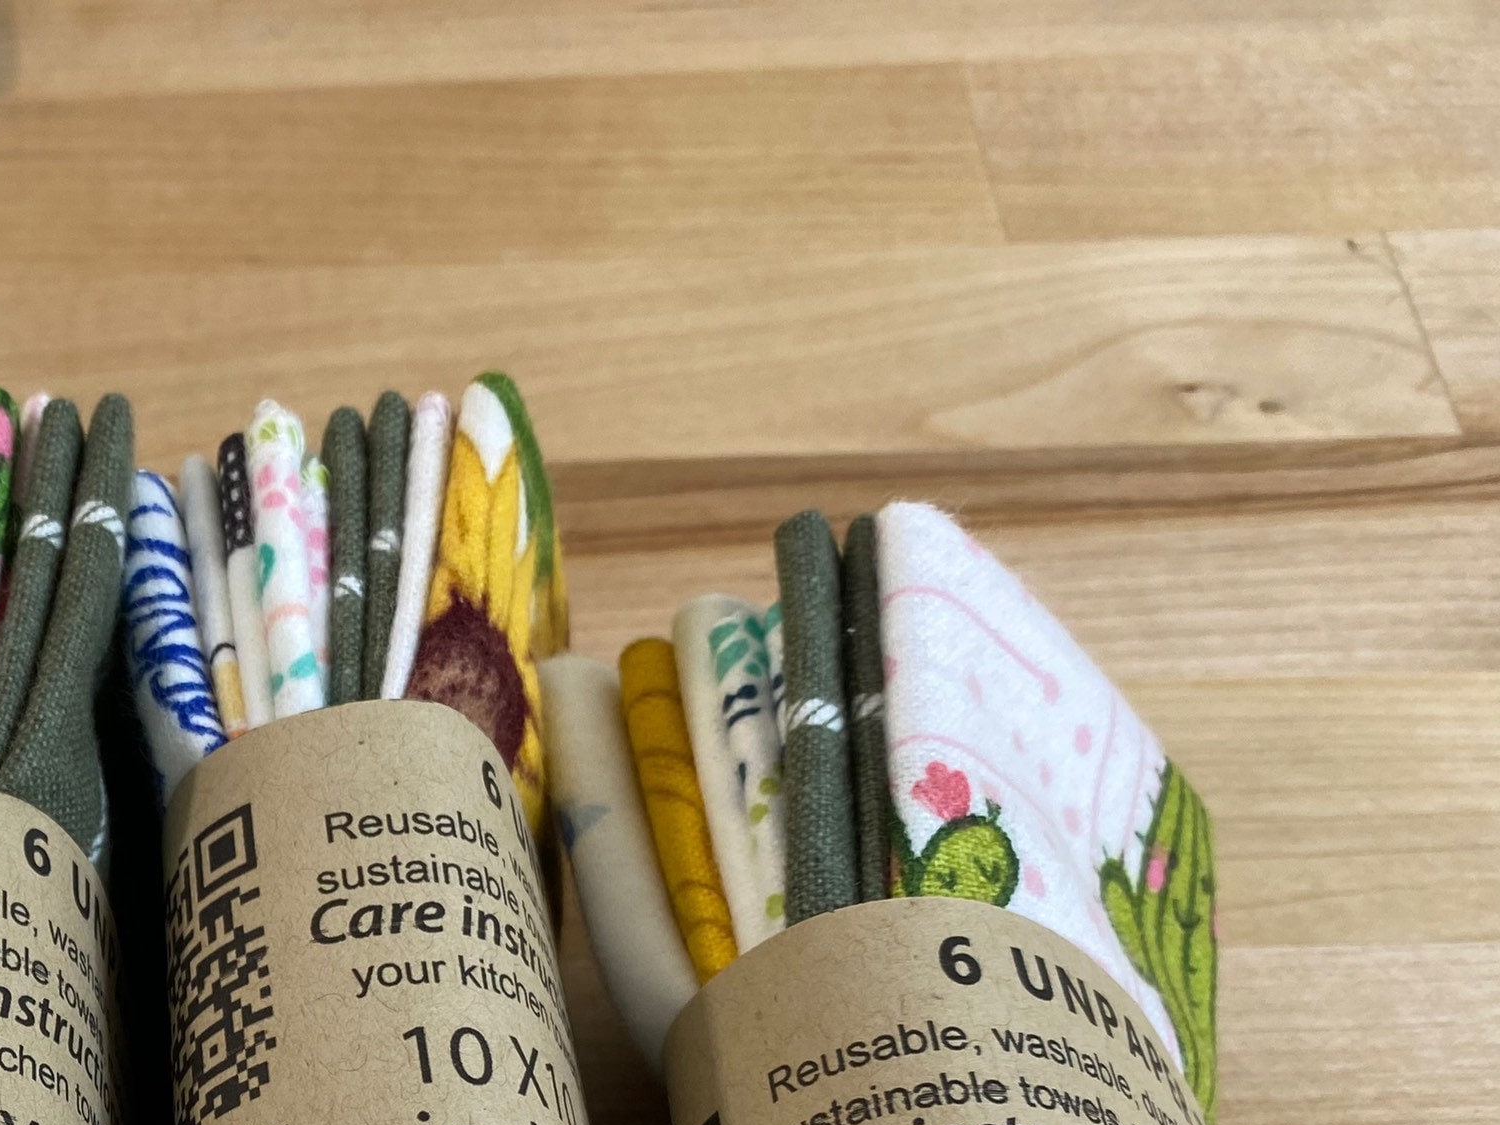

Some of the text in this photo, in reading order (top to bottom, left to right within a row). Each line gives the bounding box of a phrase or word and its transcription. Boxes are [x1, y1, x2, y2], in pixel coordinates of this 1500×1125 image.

[482, 760, 502, 810] 6
[23, 828, 52, 877] 6
[323, 809, 506, 868] Reusable,
[315, 854, 520, 916] sustainable
[309, 899, 445, 946] Care
[937, 935, 983, 986] 6
[352, 953, 551, 1031] your kitchen
[402, 1025, 494, 1086] 10
[766, 1019, 984, 1104] Reusable,
[991, 1025, 1141, 1111] washable,
